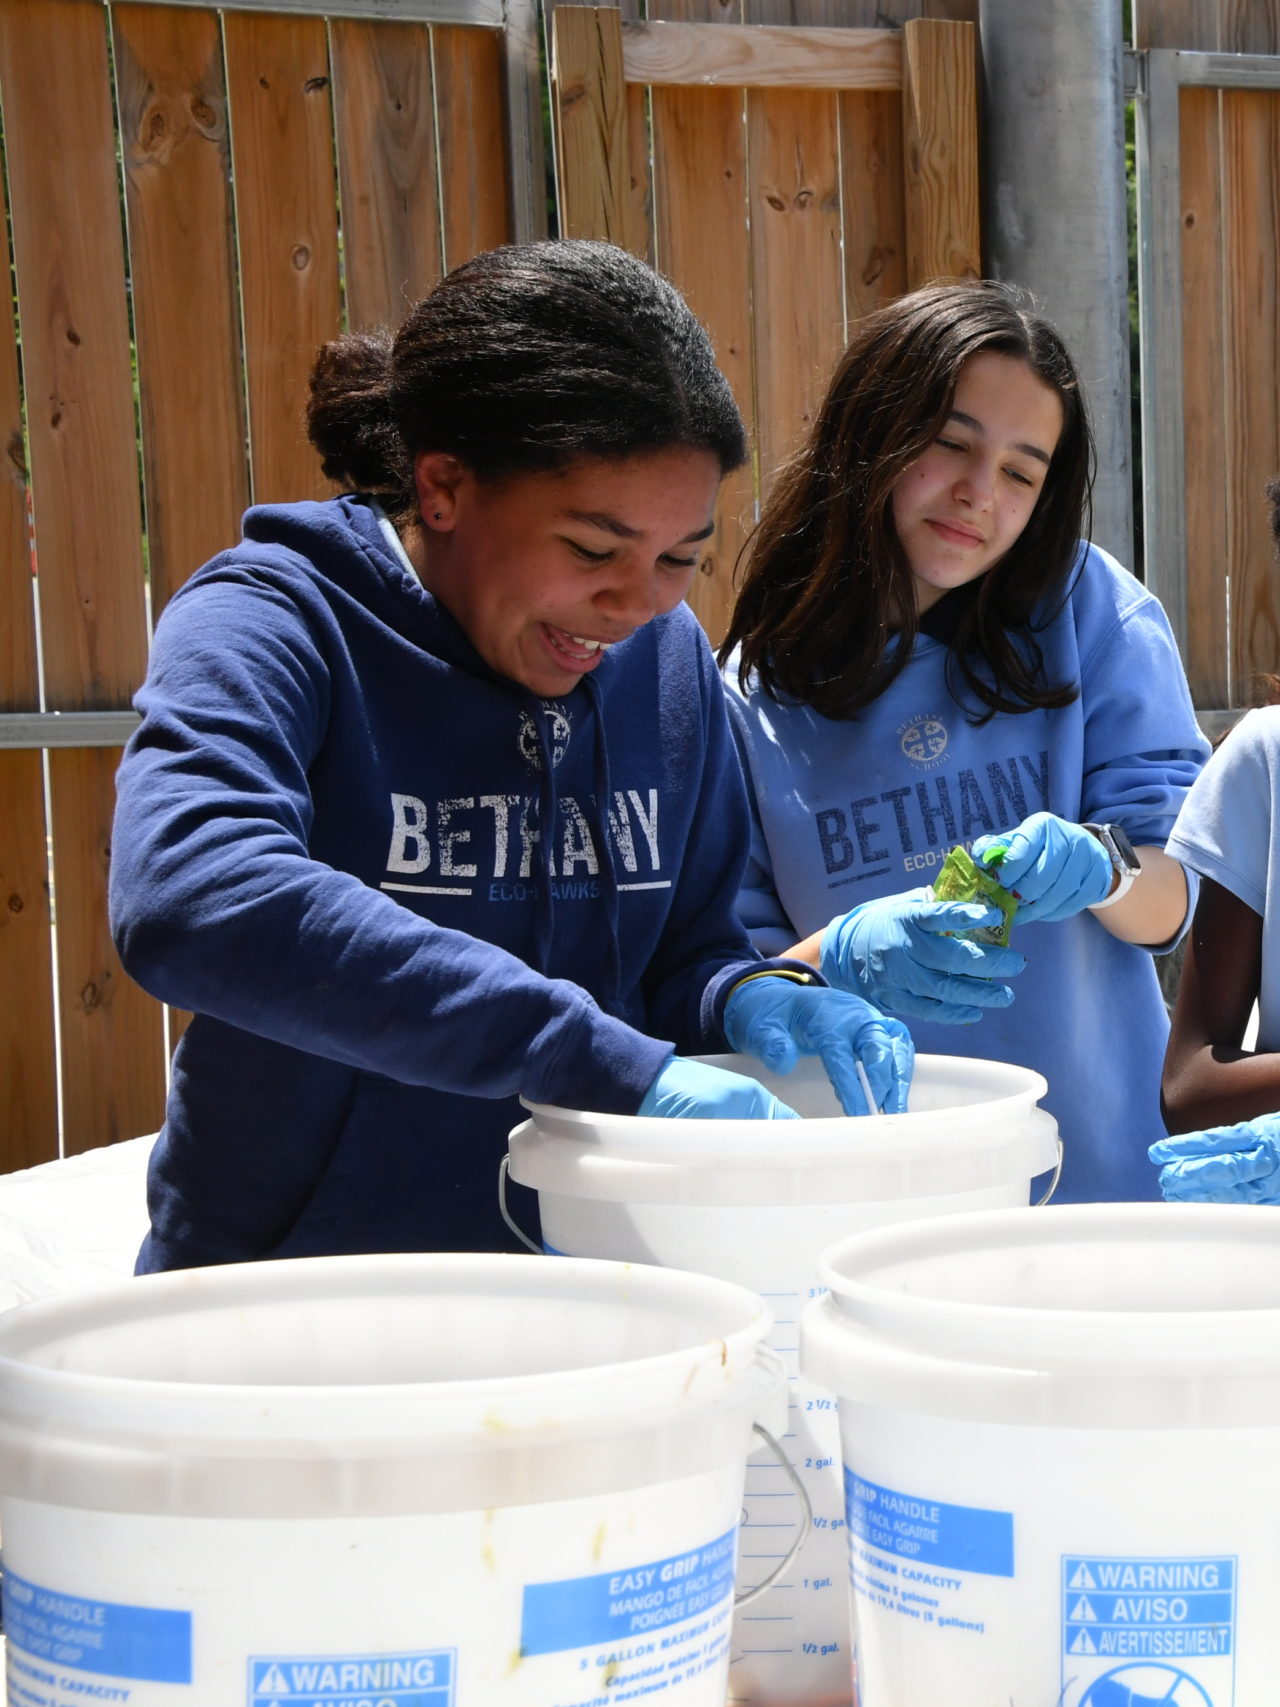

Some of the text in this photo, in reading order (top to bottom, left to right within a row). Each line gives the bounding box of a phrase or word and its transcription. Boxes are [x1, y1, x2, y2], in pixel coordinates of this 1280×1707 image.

[815, 751, 1049, 875] BETHANY
[488, 881, 600, 902] ECO-AWKS
[806, 1401, 813, 1410] 2
[816, 1399, 831, 1410] 1/2
[805, 1457, 836, 1469] 2 gal.
[880, 1493, 940, 1524] HANDLE
[831, 1519, 845, 1530] ga
[894, 1522, 939, 1544] AGARRE
[896, 1539, 921, 1555] GRIP
[609, 1568, 655, 1595] EASY
[660, 1555, 699, 1582] GRIP
[803, 1577, 832, 1590] 1 gal.
[902, 1567, 962, 1591] CAPACITY
[1098, 1564, 1219, 1589] WARNING
[609, 1590, 665, 1617] MANGO
[667, 1584, 683, 1602] DE
[1112, 1597, 1188, 1622] AVISO
[802, 1642, 840, 1656] 1/2 gal.
[1100, 1629, 1228, 1655] AVERTISSEMENT
[579, 1658, 588, 1671] 5
[596, 1643, 655, 1667] GALLON
[291, 1658, 435, 1693] WARNING
